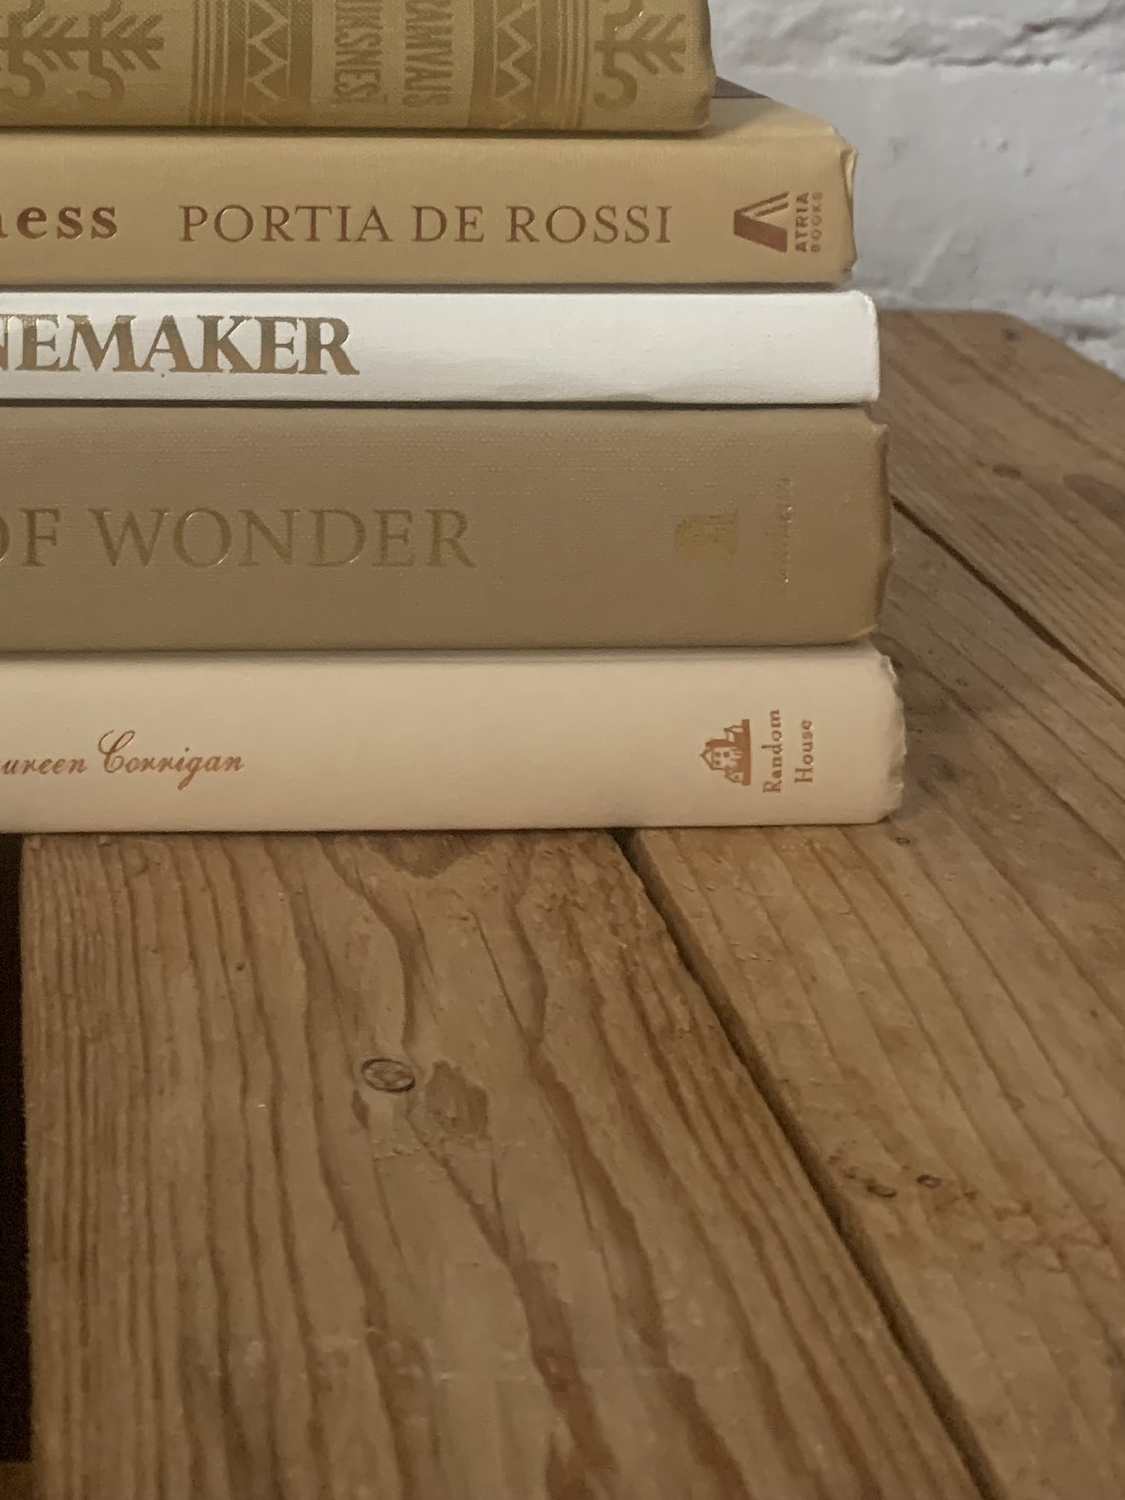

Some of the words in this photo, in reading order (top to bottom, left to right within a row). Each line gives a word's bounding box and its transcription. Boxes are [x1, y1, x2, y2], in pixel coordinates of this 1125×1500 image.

[178, 203, 391, 243] PORTIA
[411, 204, 485, 243] DE
[506, 204, 671, 244] ROSSI
[795, 192, 809, 253] ATRIA
[811, 191, 823, 253] BOOKS
[88, 507, 476, 568] WONDER
[98, 729, 244, 791] Corrigan
[761, 709, 782, 793] Random
[795, 719, 814, 783] House
